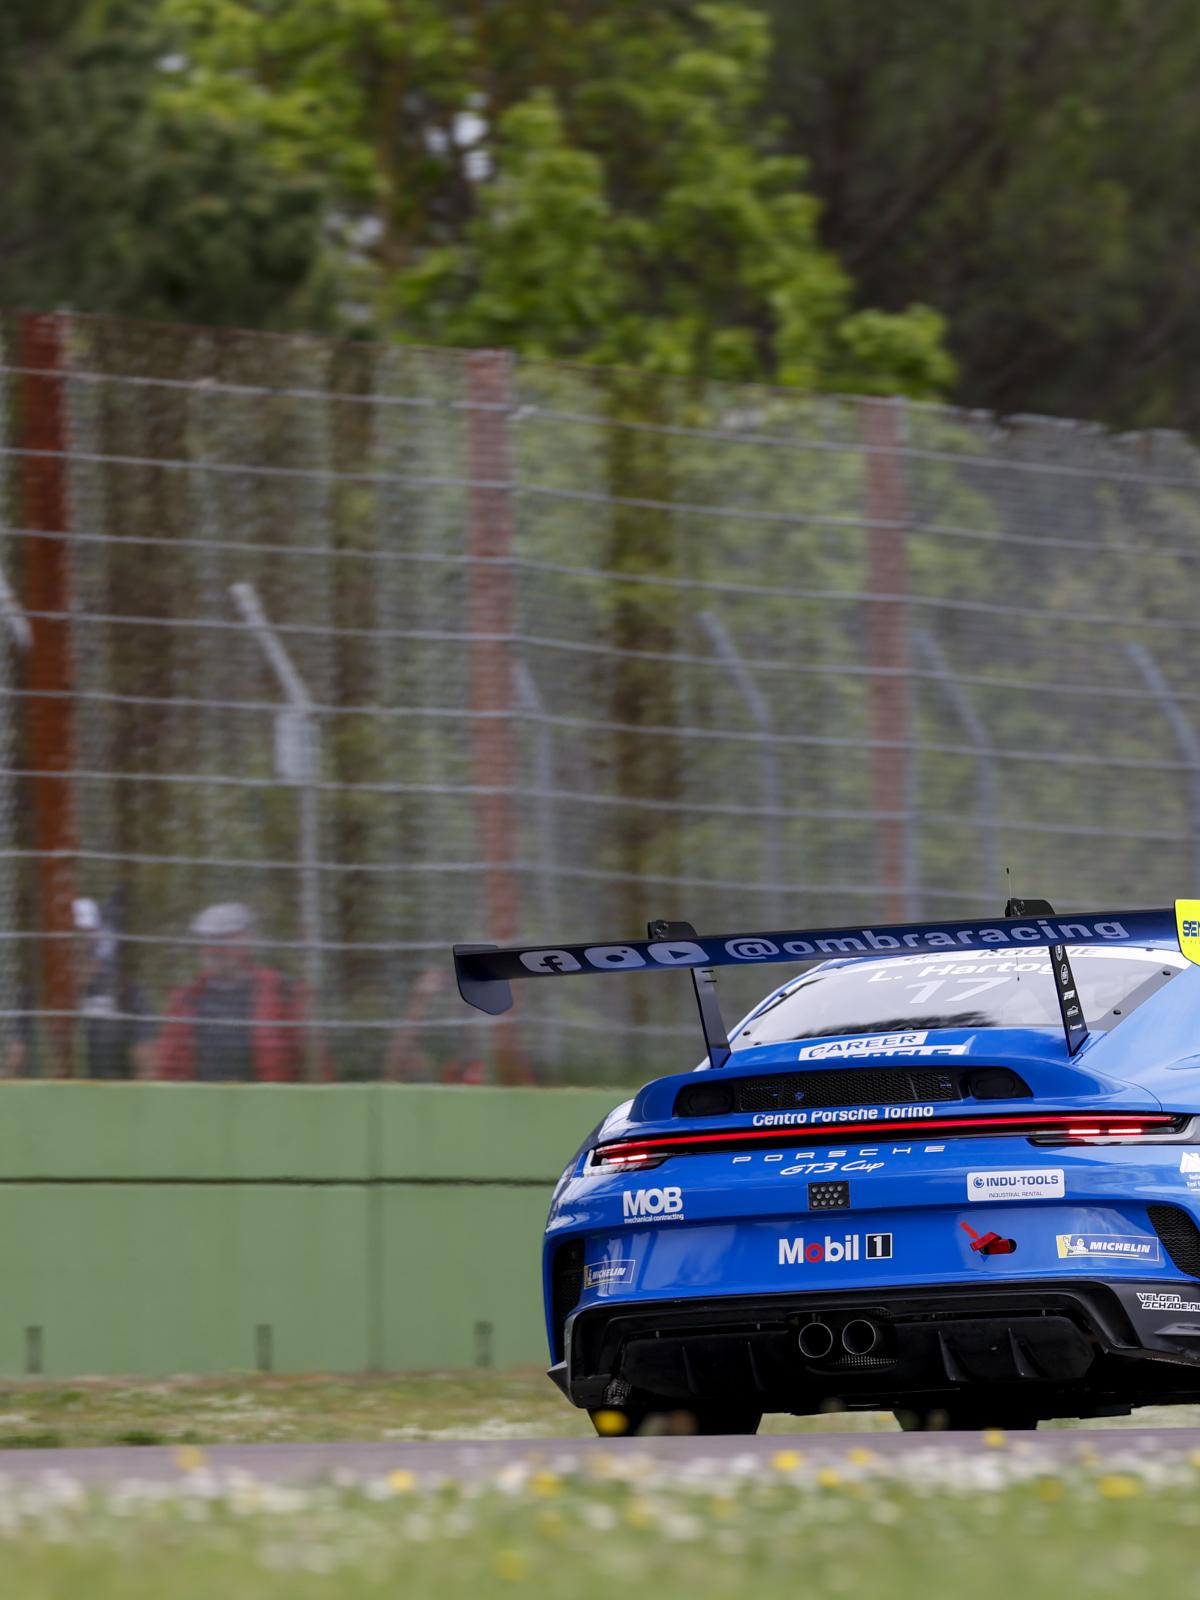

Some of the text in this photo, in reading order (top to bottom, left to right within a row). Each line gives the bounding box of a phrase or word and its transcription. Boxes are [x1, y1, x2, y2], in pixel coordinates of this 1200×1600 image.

[725, 919, 1130, 960] @ombraracing
[978, 947, 1100, 958] ROOIE
[868, 970, 903, 982] L.
[904, 976, 1012, 1004] 17
[808, 1035, 917, 1058] CAREER
[753, 1105, 934, 1127] Centro Porsche Torino
[732, 1145, 946, 1164] PORSCHE
[779, 1160, 885, 1175] GT3 Cup
[986, 1175, 1059, 1187] INDU-TOOLS
[623, 1186, 683, 1217] MOB
[624, 1213, 684, 1224] mechanical contracting
[779, 1234, 859, 1265] Mobil
[1089, 1241, 1151, 1253] MICHELIN
[592, 1268, 626, 1280] MICHELIN
